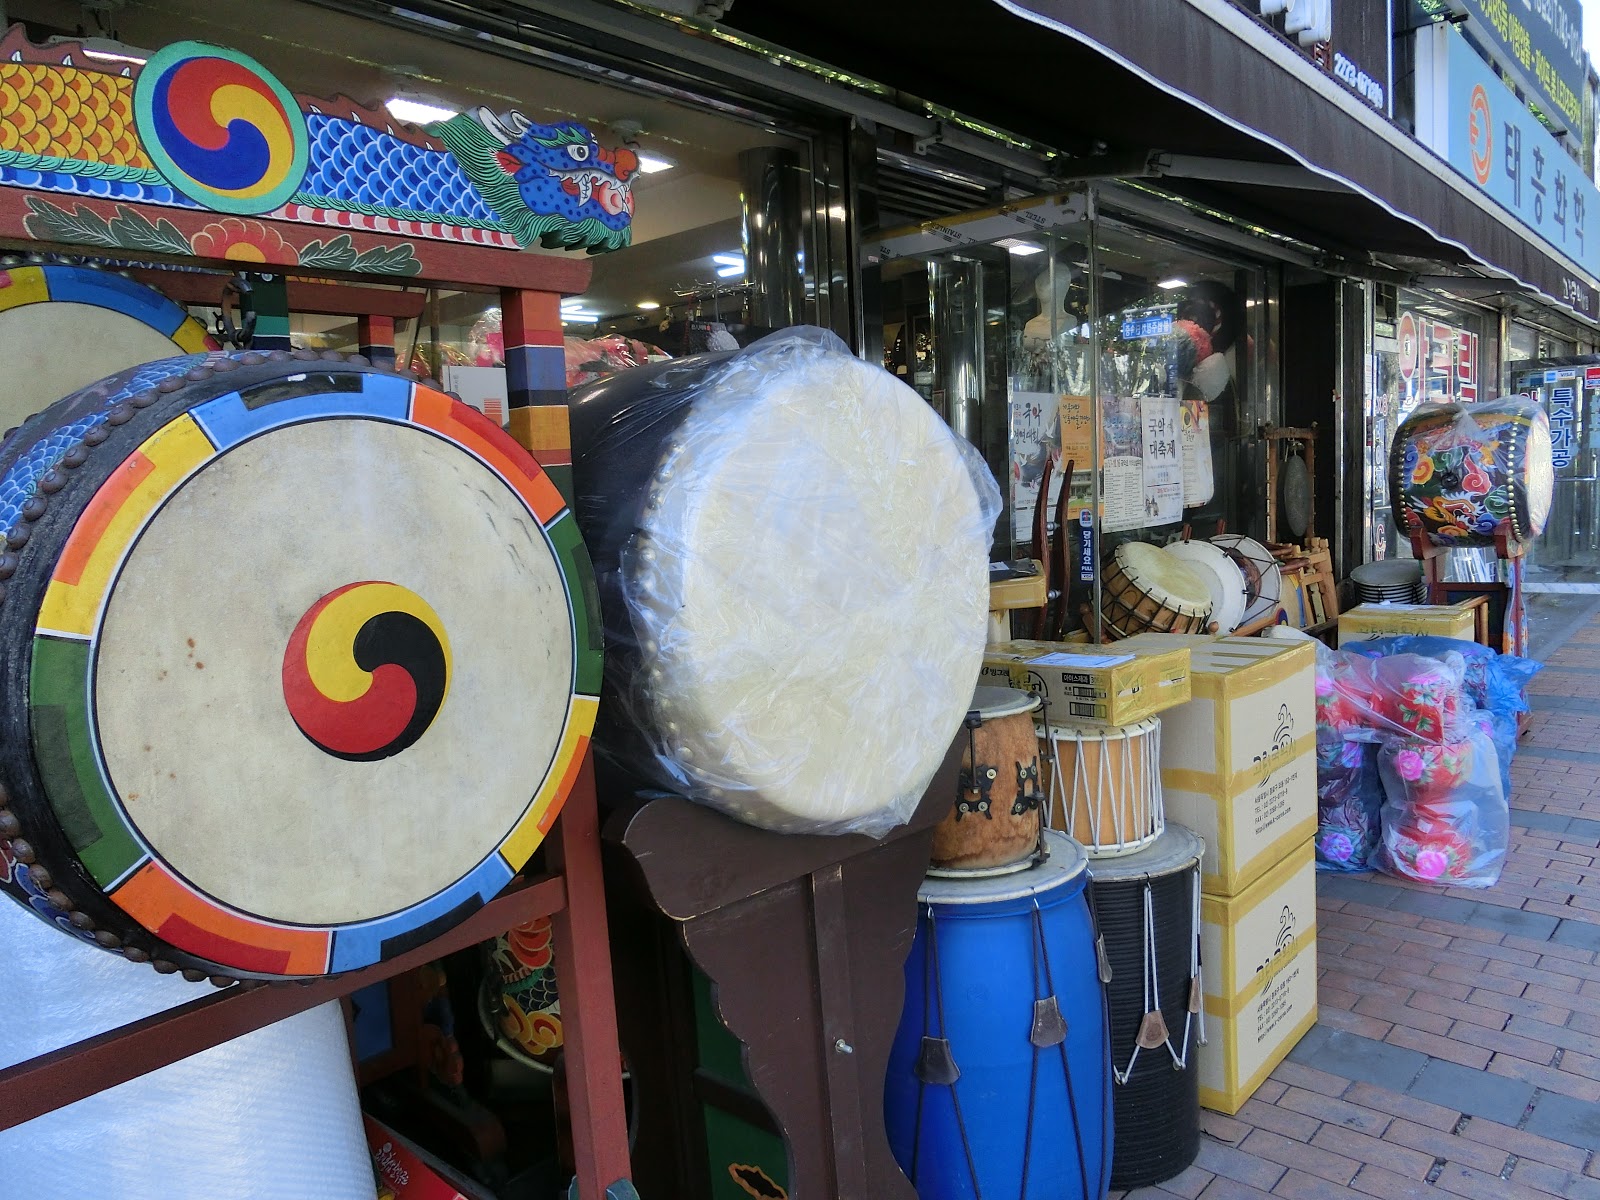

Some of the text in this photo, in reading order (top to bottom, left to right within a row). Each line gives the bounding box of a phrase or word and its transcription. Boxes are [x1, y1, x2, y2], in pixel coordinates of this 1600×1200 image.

[1504, 121, 1586, 258] 태흥화학
[1022, 402, 1043, 428] 국악
[1149, 417, 1165, 438] 국악
[1551, 388, 1573, 468] 특수가공
[1013, 427, 1041, 447] 경연대회
[1149, 440, 1176, 460] 대축제
[1083, 530, 1092, 565] 당기세요
